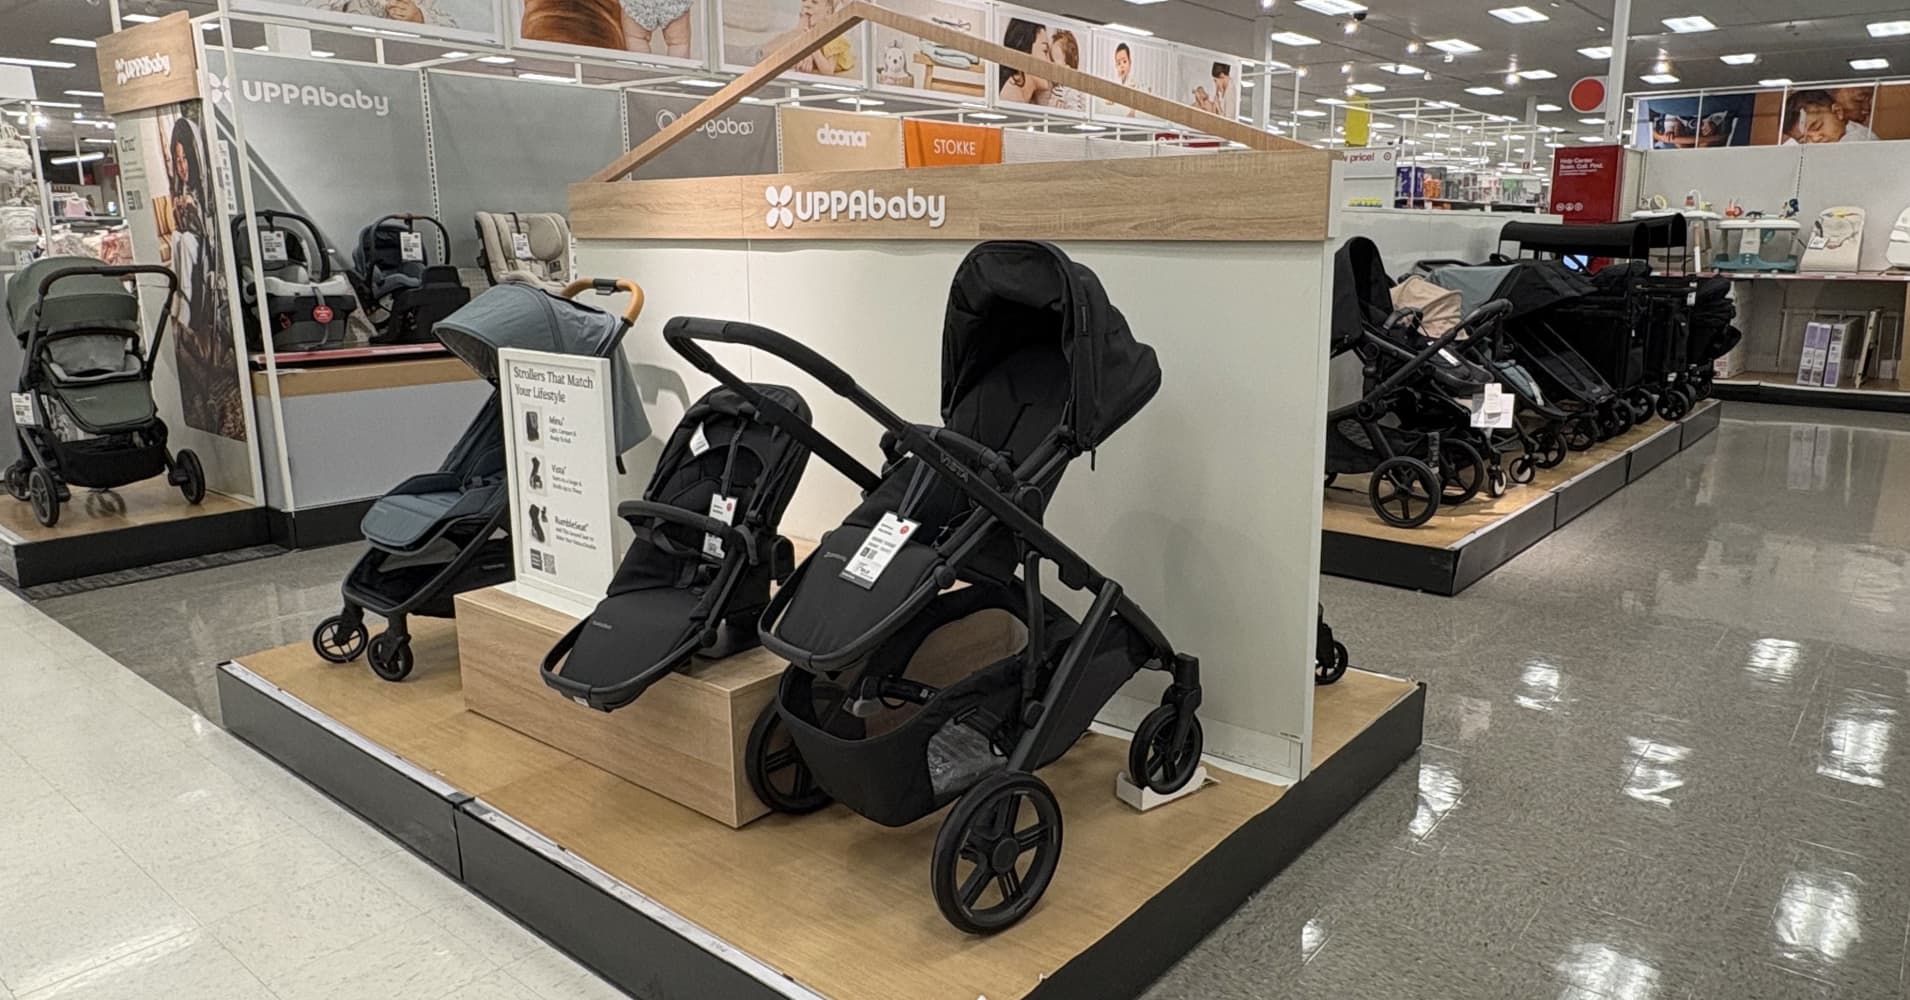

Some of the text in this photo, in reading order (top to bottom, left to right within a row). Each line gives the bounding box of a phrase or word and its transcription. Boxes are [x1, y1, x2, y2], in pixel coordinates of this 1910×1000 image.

[242, 79, 390, 117] UPPAbaby
[817, 123, 867, 148] doona
[933, 138, 977, 156] STOKKE
[795, 187, 946, 228] UPPAbaby
[513, 366, 594, 389] Strollers That Match
[515, 383, 566, 404] Your Lifestyle
